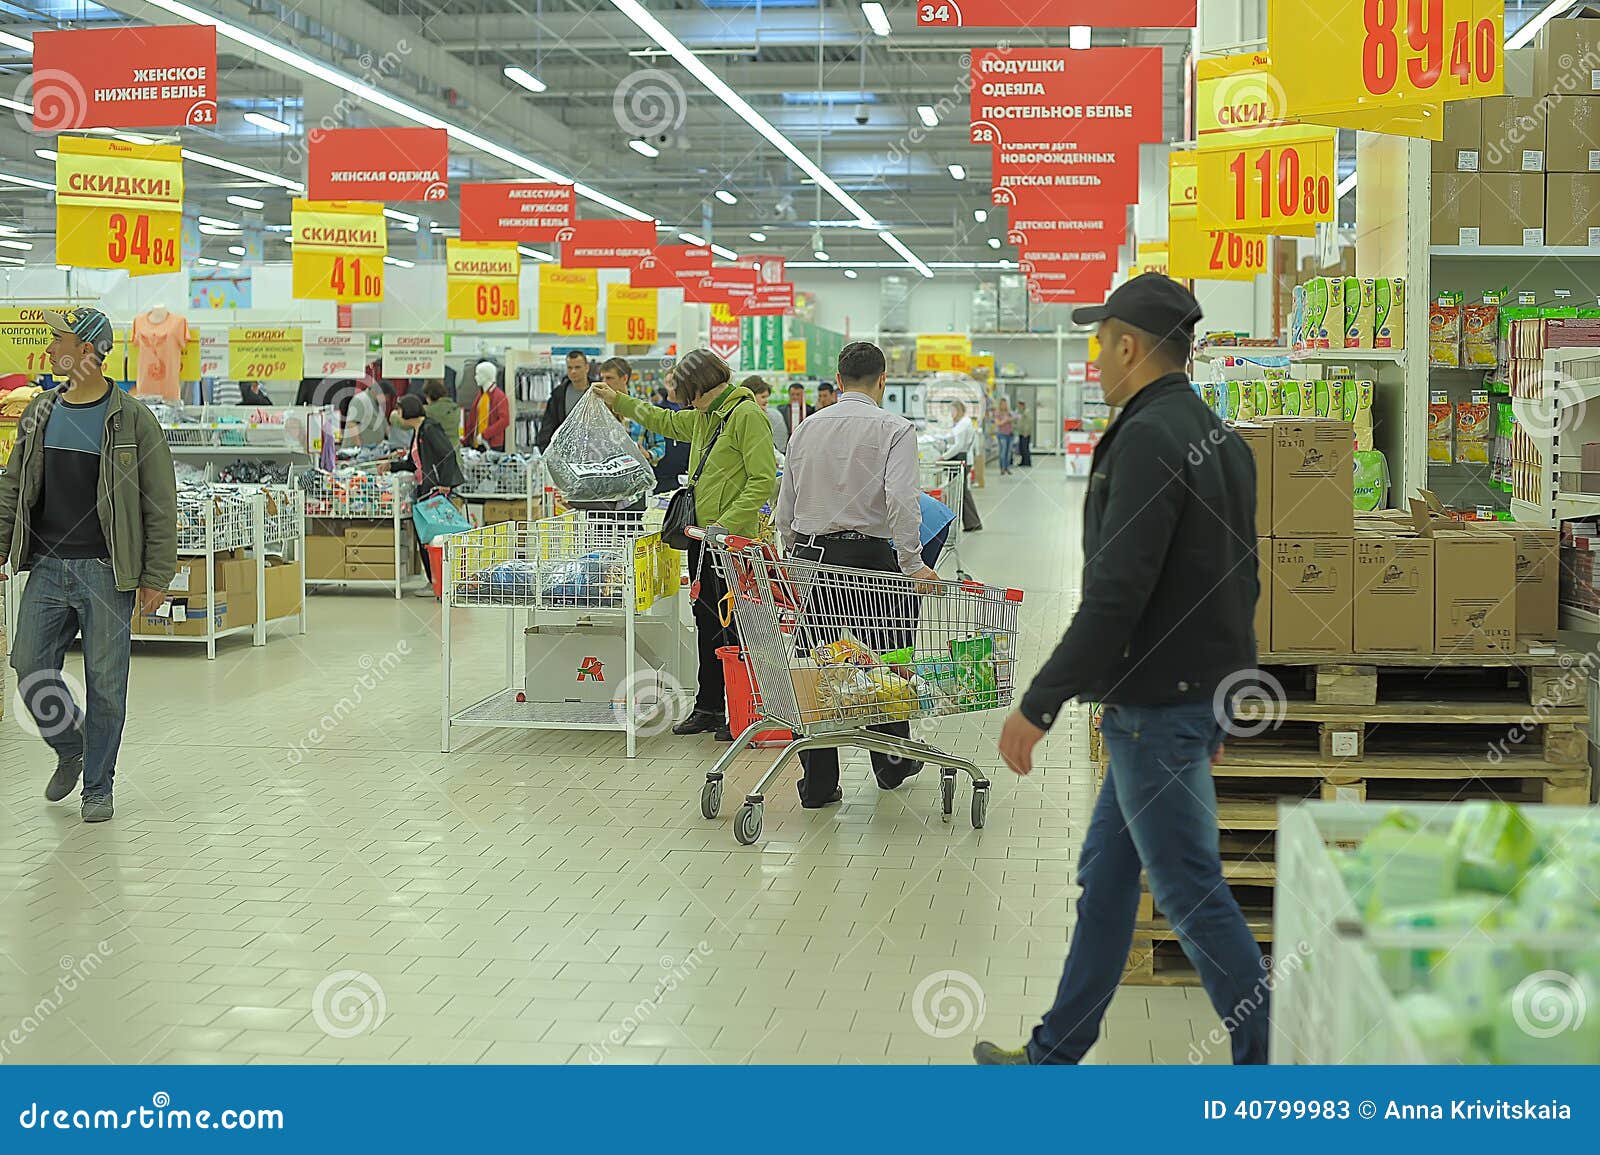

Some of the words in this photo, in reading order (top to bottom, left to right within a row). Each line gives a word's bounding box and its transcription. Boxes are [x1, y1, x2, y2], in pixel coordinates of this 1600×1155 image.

[921, 5, 949, 22] 34
[1362, 0, 1443, 95] 89
[1450, 18, 1495, 85] 40
[982, 59, 1065, 73] ПОДУШКИ
[133, 67, 206, 82] ЖЕНСКОЕ
[94, 86, 158, 102] НИЖНЕЕ
[161, 85, 206, 99] БЕЛЬЕ
[981, 83, 1045, 97] ОДЕЯЛА
[193, 109, 213, 122] 31
[982, 105, 1082, 119] ПОСТЕЛЬНОЕ
[1086, 105, 1133, 119] БЕЛЬЕ
[973, 130, 993, 142] 28
[1000, 153, 1115, 165] НОВОРОЖДЕННЫХ
[330, 171, 387, 182] ЖЕНСКАЯ
[388, 170, 440, 183] ОДЕЖДА
[1000, 176, 1052, 187] ДЕТСКАЯ
[1055, 176, 1101, 186] МЕБЕЛЬ
[69, 173, 171, 195] СКИДКИ!
[1230, 147, 1300, 221] 110
[1303, 175, 1330, 214] 80
[430, 188, 445, 199] 29
[508, 189, 570, 199] АКСЕССУАРЫ
[994, 193, 1010, 203] 26
[108, 213, 150, 265] 34
[153, 238, 174, 266] 84
[302, 227, 377, 243] СКИДКИ!
[1245, 240, 1264, 268] 90
[454, 260, 512, 273] СКИДКИ!
[330, 256, 361, 296] 41
[364, 275, 381, 296] 00
[476, 284, 501, 316] 69
[562, 303, 582, 331] 42
[1, 327, 47, 335] КОЛГОТКИ
[11, 337, 48, 345] ТЕПЛЫЕ
